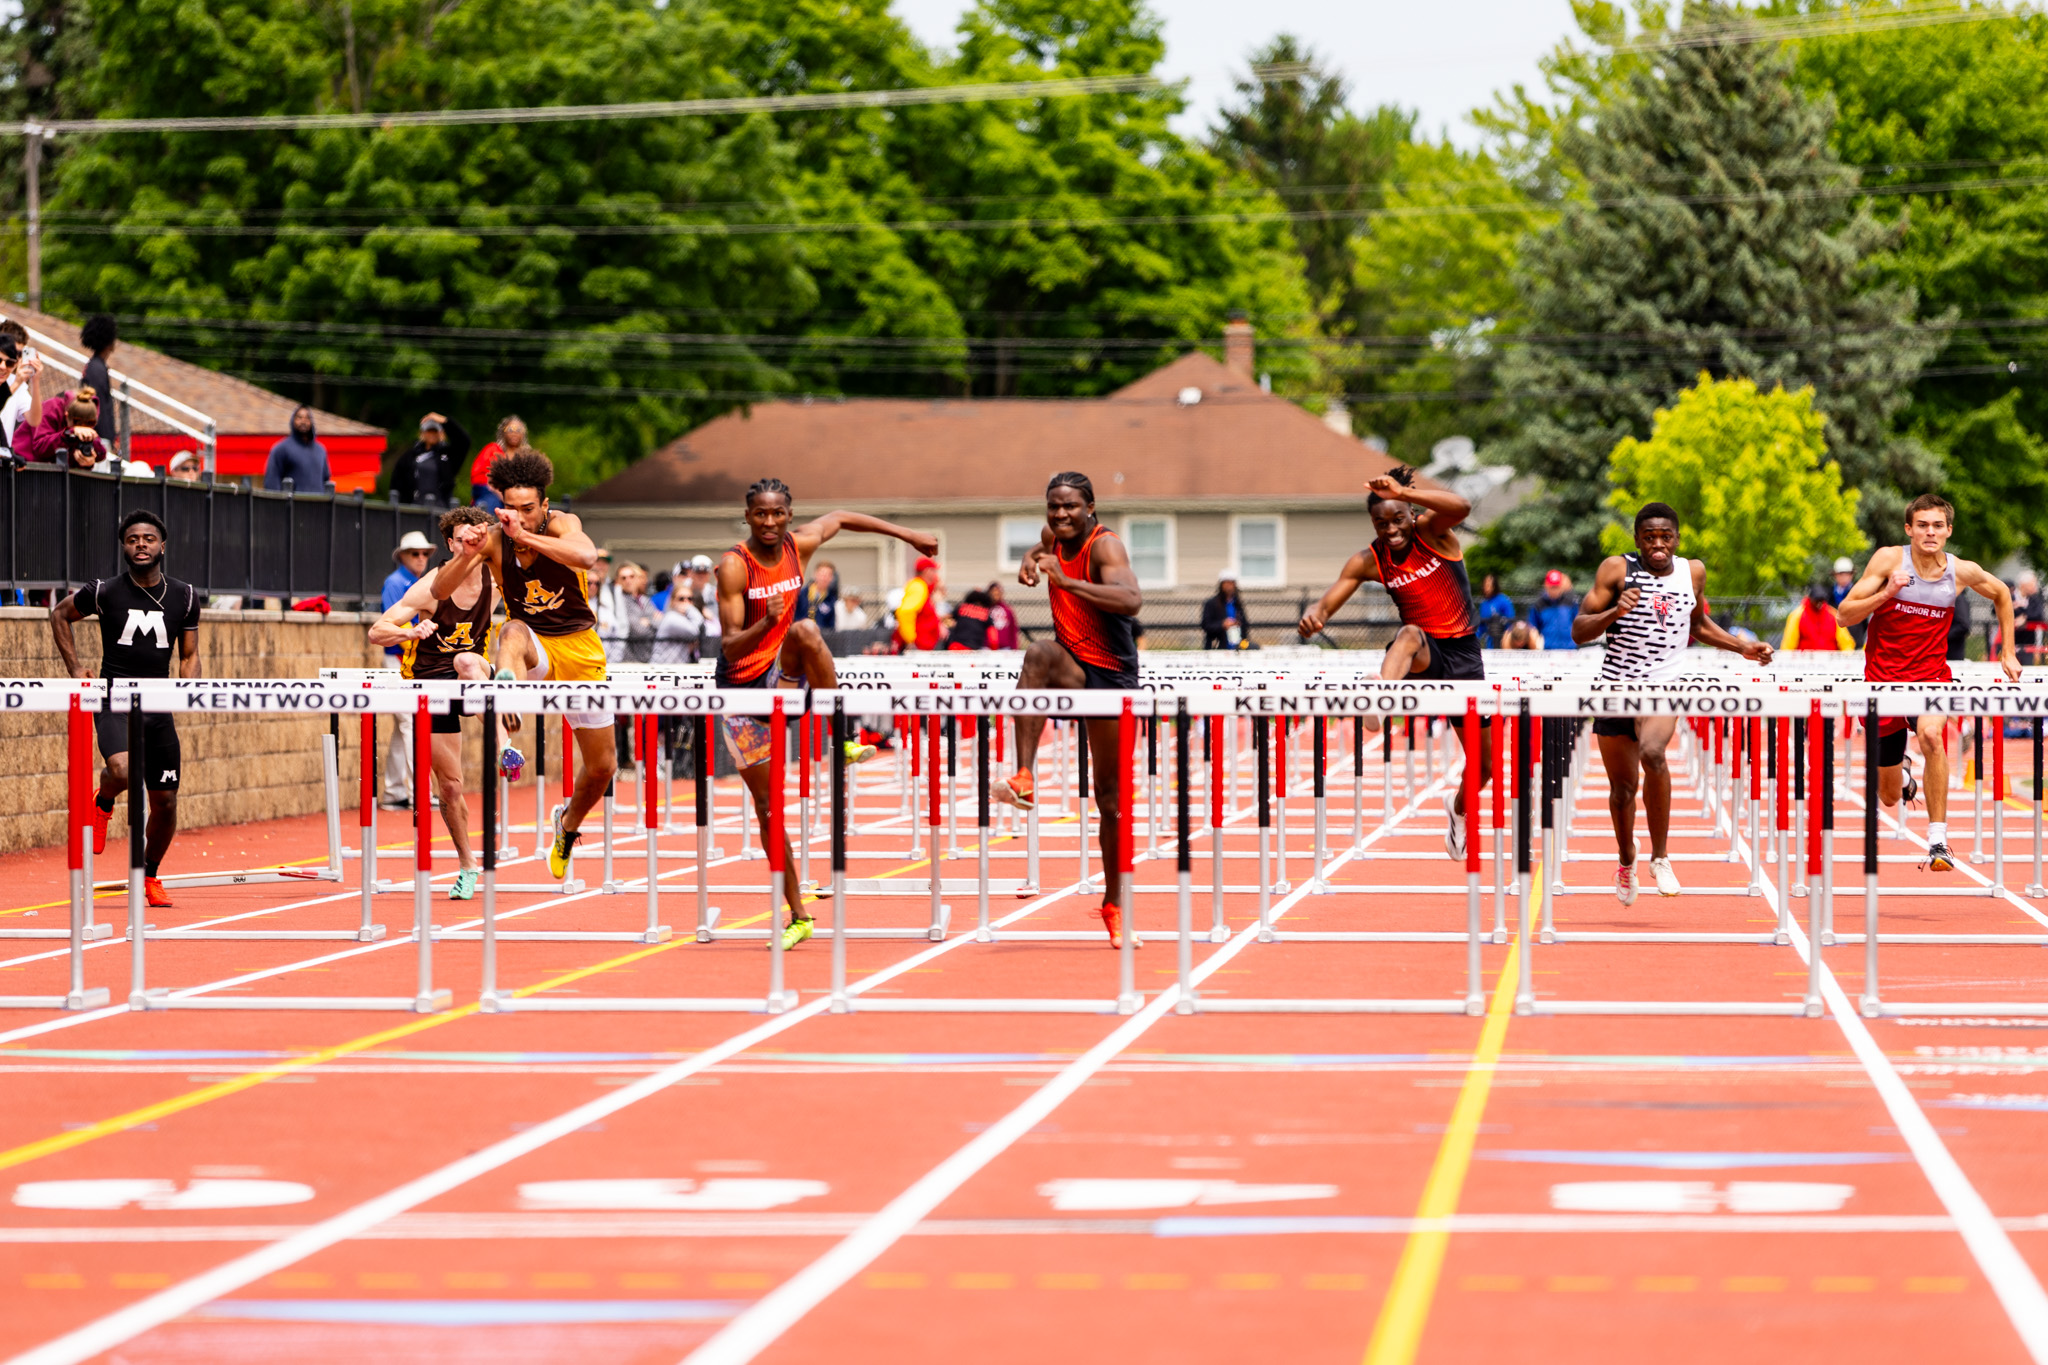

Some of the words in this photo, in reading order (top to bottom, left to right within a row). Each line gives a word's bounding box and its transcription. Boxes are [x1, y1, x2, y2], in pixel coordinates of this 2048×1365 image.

[524, 579, 556, 604] A
[1894, 602, 1929, 617] ANCHOR
[1930, 610, 1947, 619] BAY
[117, 608, 170, 649] M
[444, 622, 474, 645] A
[187, 693, 371, 709] KENTWOOD
[542, 695, 726, 710] KENTWOOD
[890, 695, 1074, 711] KENTWOOD
[1235, 695, 1418, 711] KENTWOOD
[1578, 697, 1763, 712] KENTWOOD
[1924, 697, 2048, 712] KENTW
[160, 769, 178, 783] M
